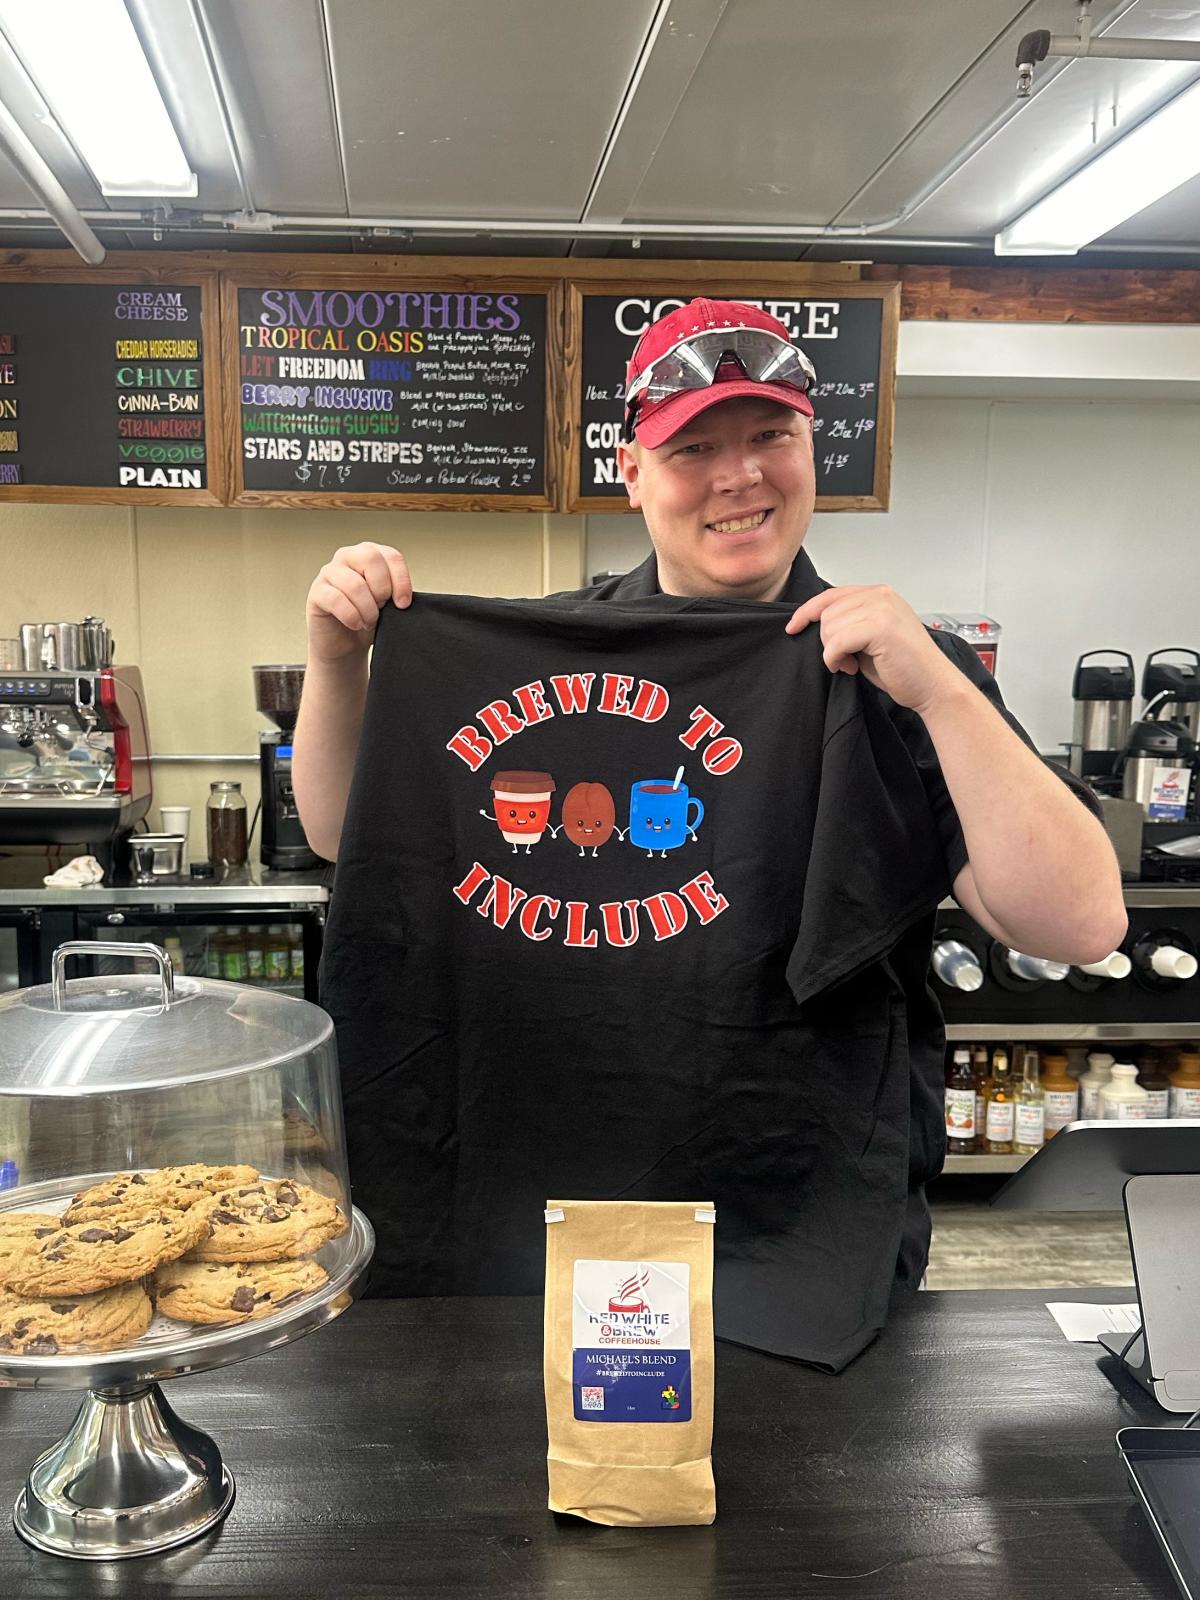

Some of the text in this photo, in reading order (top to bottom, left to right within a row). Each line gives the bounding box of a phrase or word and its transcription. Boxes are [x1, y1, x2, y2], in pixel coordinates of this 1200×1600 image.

[117, 292, 182, 307] CREAM
[114, 306, 189, 322] CHEESE
[260, 290, 521, 331] SMOOTHIES
[116, 340, 198, 359] CHEDDAR HORSERADISH
[240, 326, 424, 353] TROPICAL OASIS
[116, 367, 198, 388] CHIVE
[240, 355, 412, 381] LET FREEDOM RING
[118, 393, 199, 411] CINNA-BUN
[117, 418, 202, 438] STRAWBERRY
[243, 413, 399, 435] WATERMELON SLUSHY
[585, 422, 627, 449] COL
[119, 444, 205, 463] veggie
[244, 437, 424, 464] STARS AND STRIPES
[119, 466, 202, 488] PLAIN
[446, 672, 743, 776] BREWED TO
[453, 861, 730, 948] INCLUDE
[621, 1313, 670, 1325] WHITE
[598, 1337, 662, 1345] COFFEEHOUSE
[586, 1354, 677, 1364] MICHAEL'S BLEND
